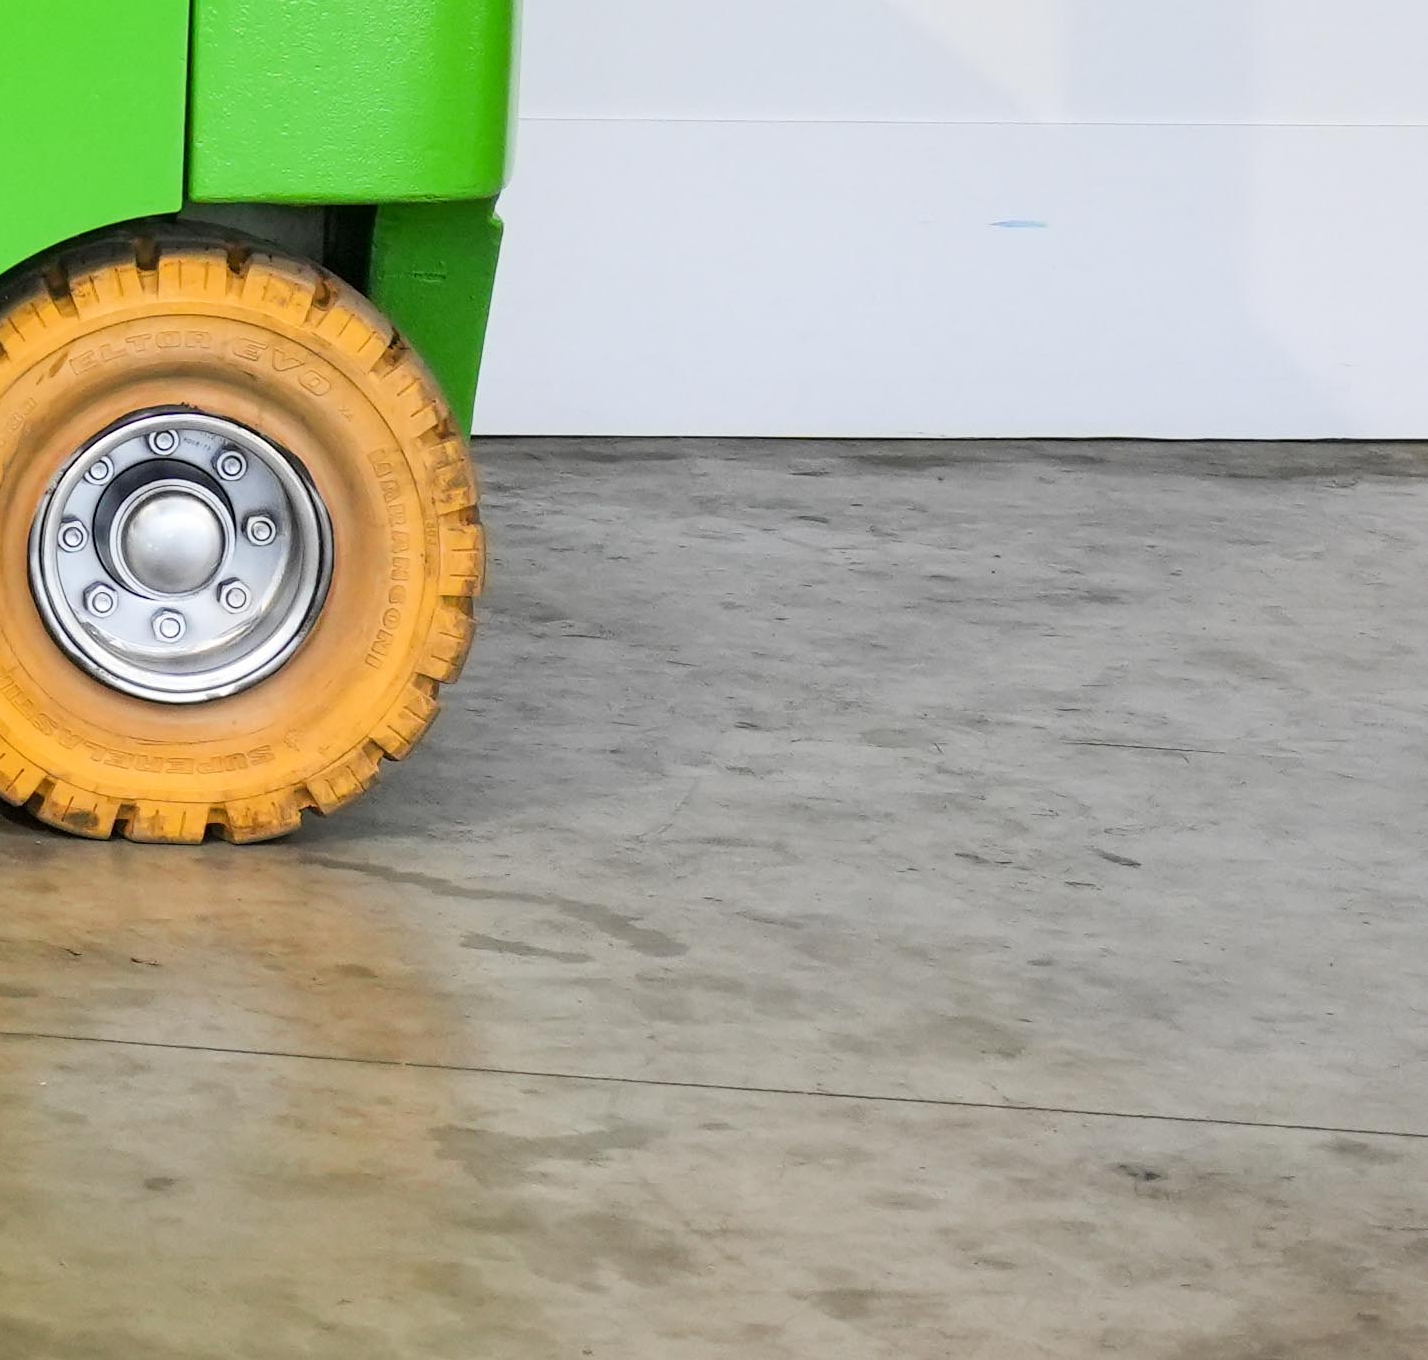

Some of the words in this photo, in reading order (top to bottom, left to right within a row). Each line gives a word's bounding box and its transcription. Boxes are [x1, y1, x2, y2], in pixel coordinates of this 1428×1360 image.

[69, 330, 212, 375] ELTOR
[232, 337, 332, 396] EVO
[367, 448, 411, 670] MARANGONI
